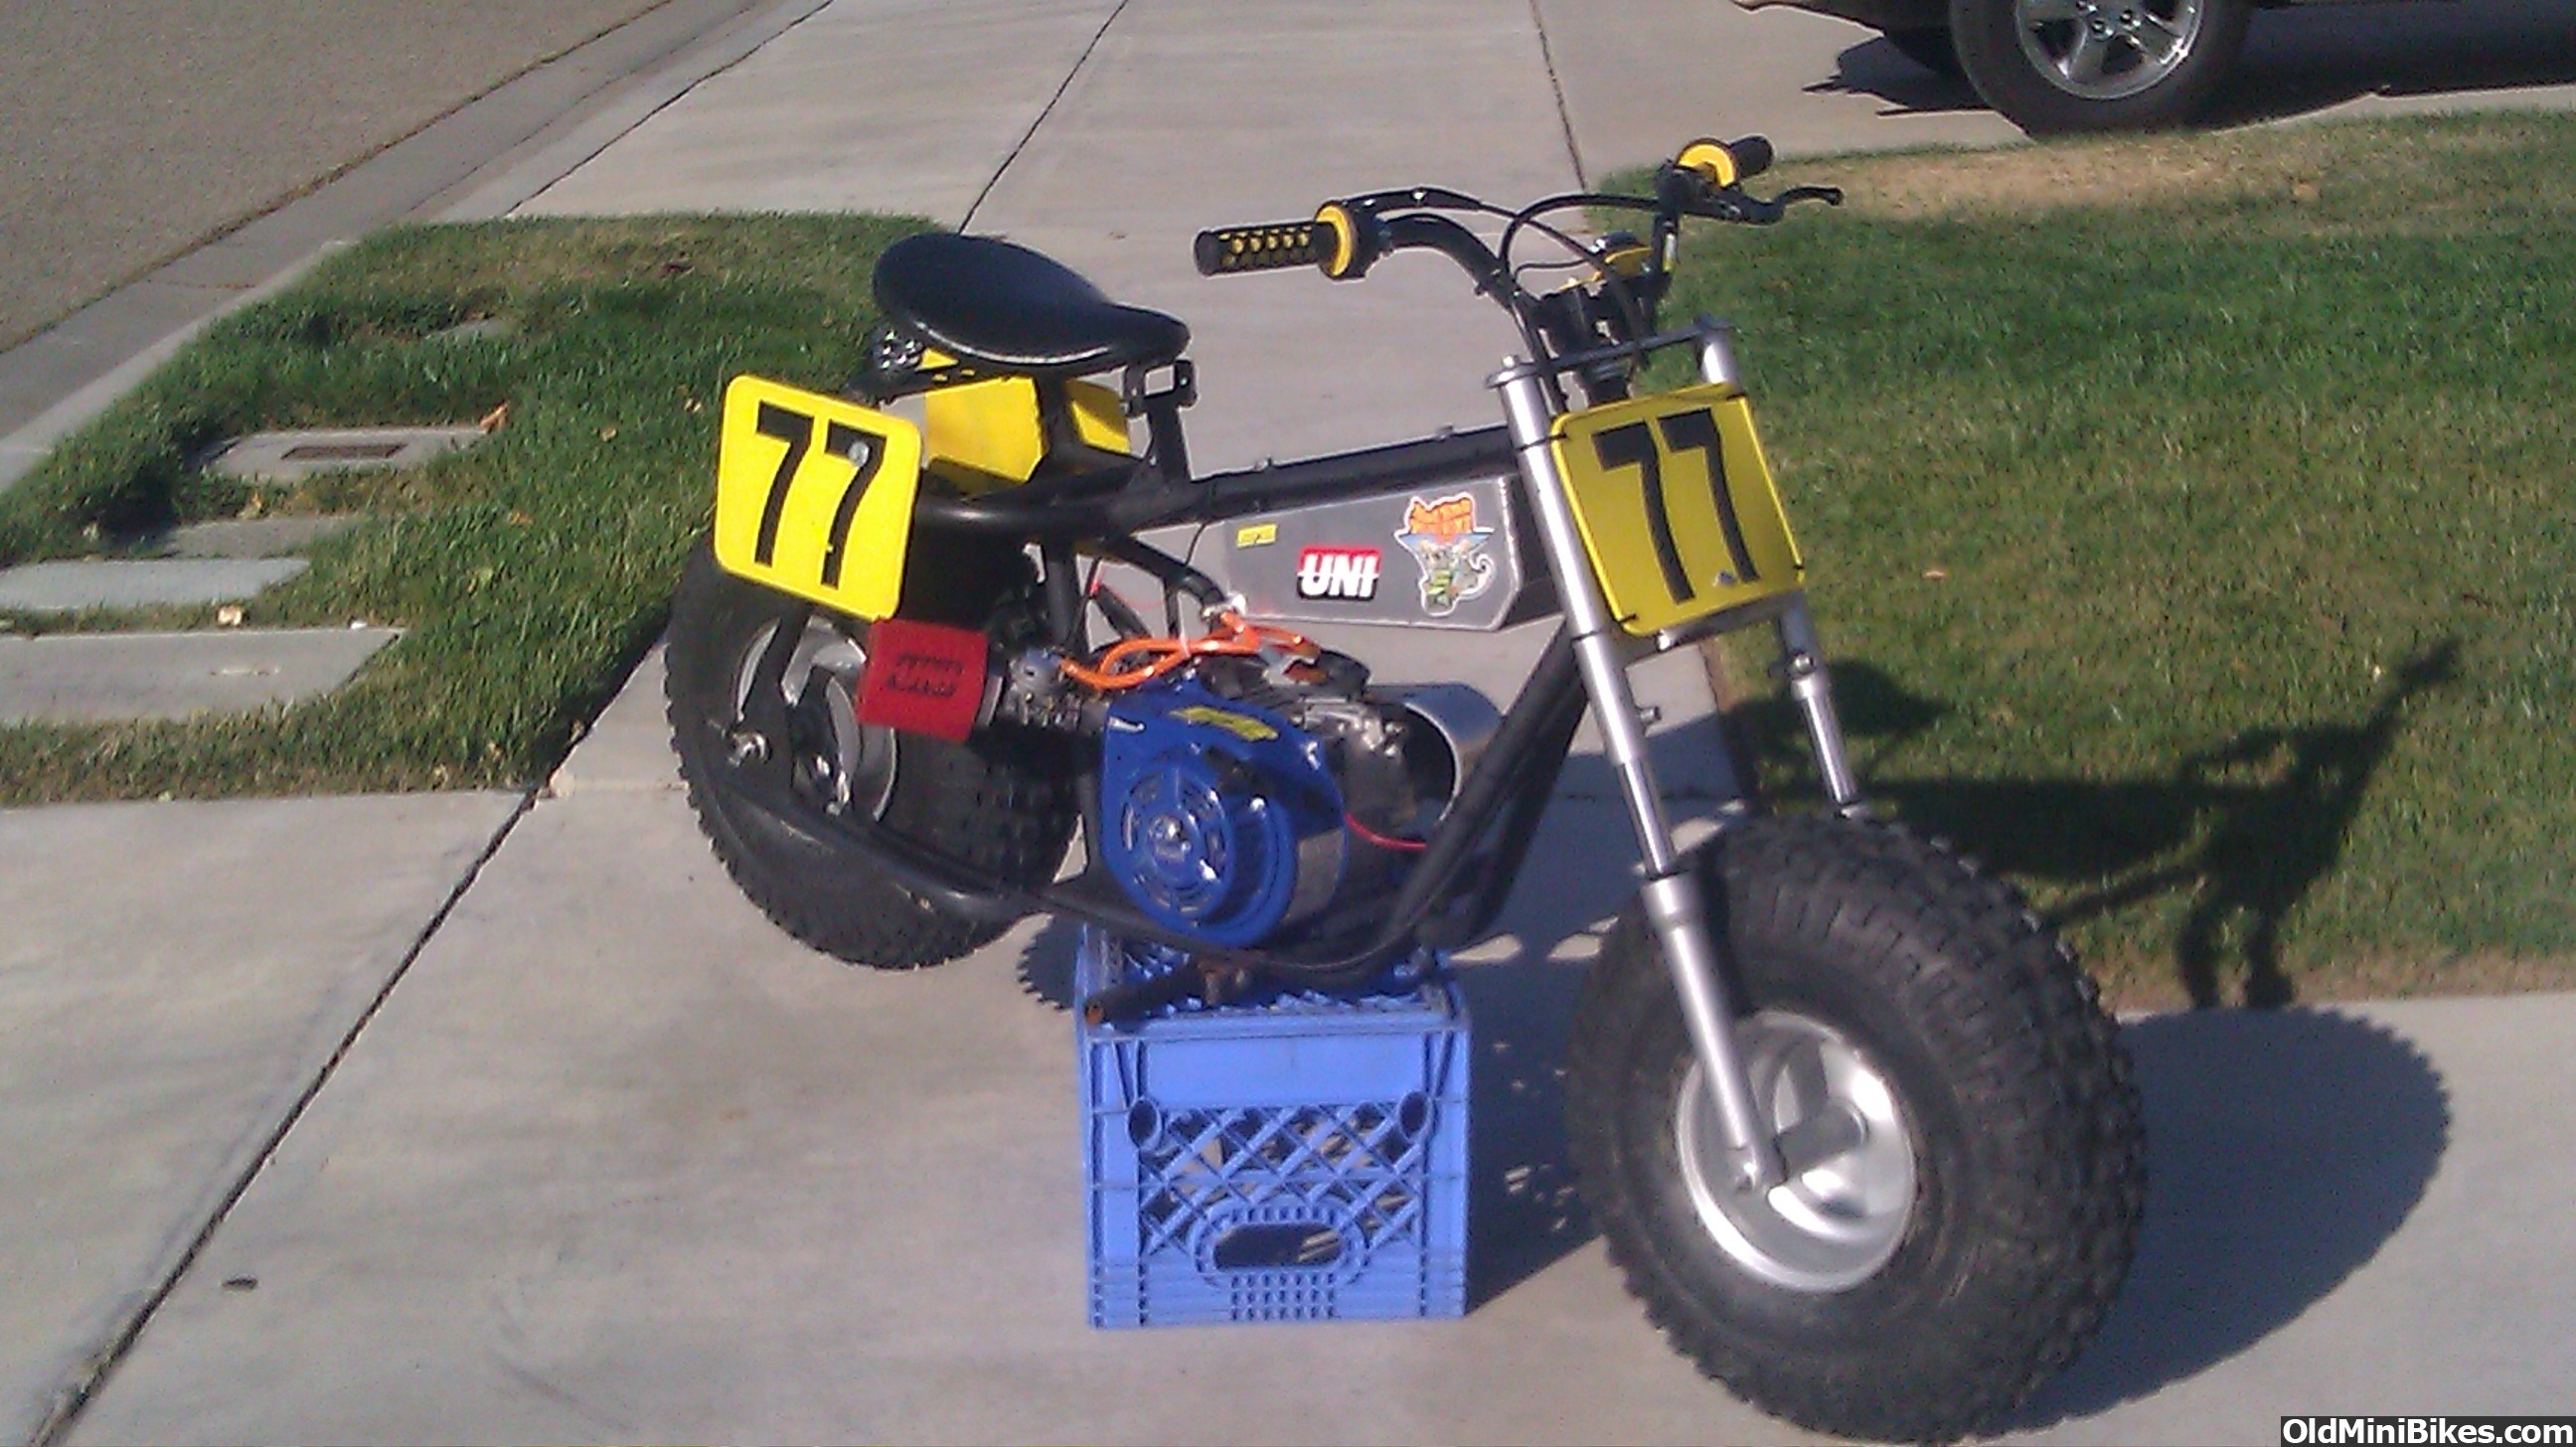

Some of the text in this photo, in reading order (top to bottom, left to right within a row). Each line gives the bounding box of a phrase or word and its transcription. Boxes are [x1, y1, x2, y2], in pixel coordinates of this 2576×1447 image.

[755, 400, 886, 590] 77
[1297, 552, 1378, 598] UNI
[1591, 407, 1760, 604] 77
